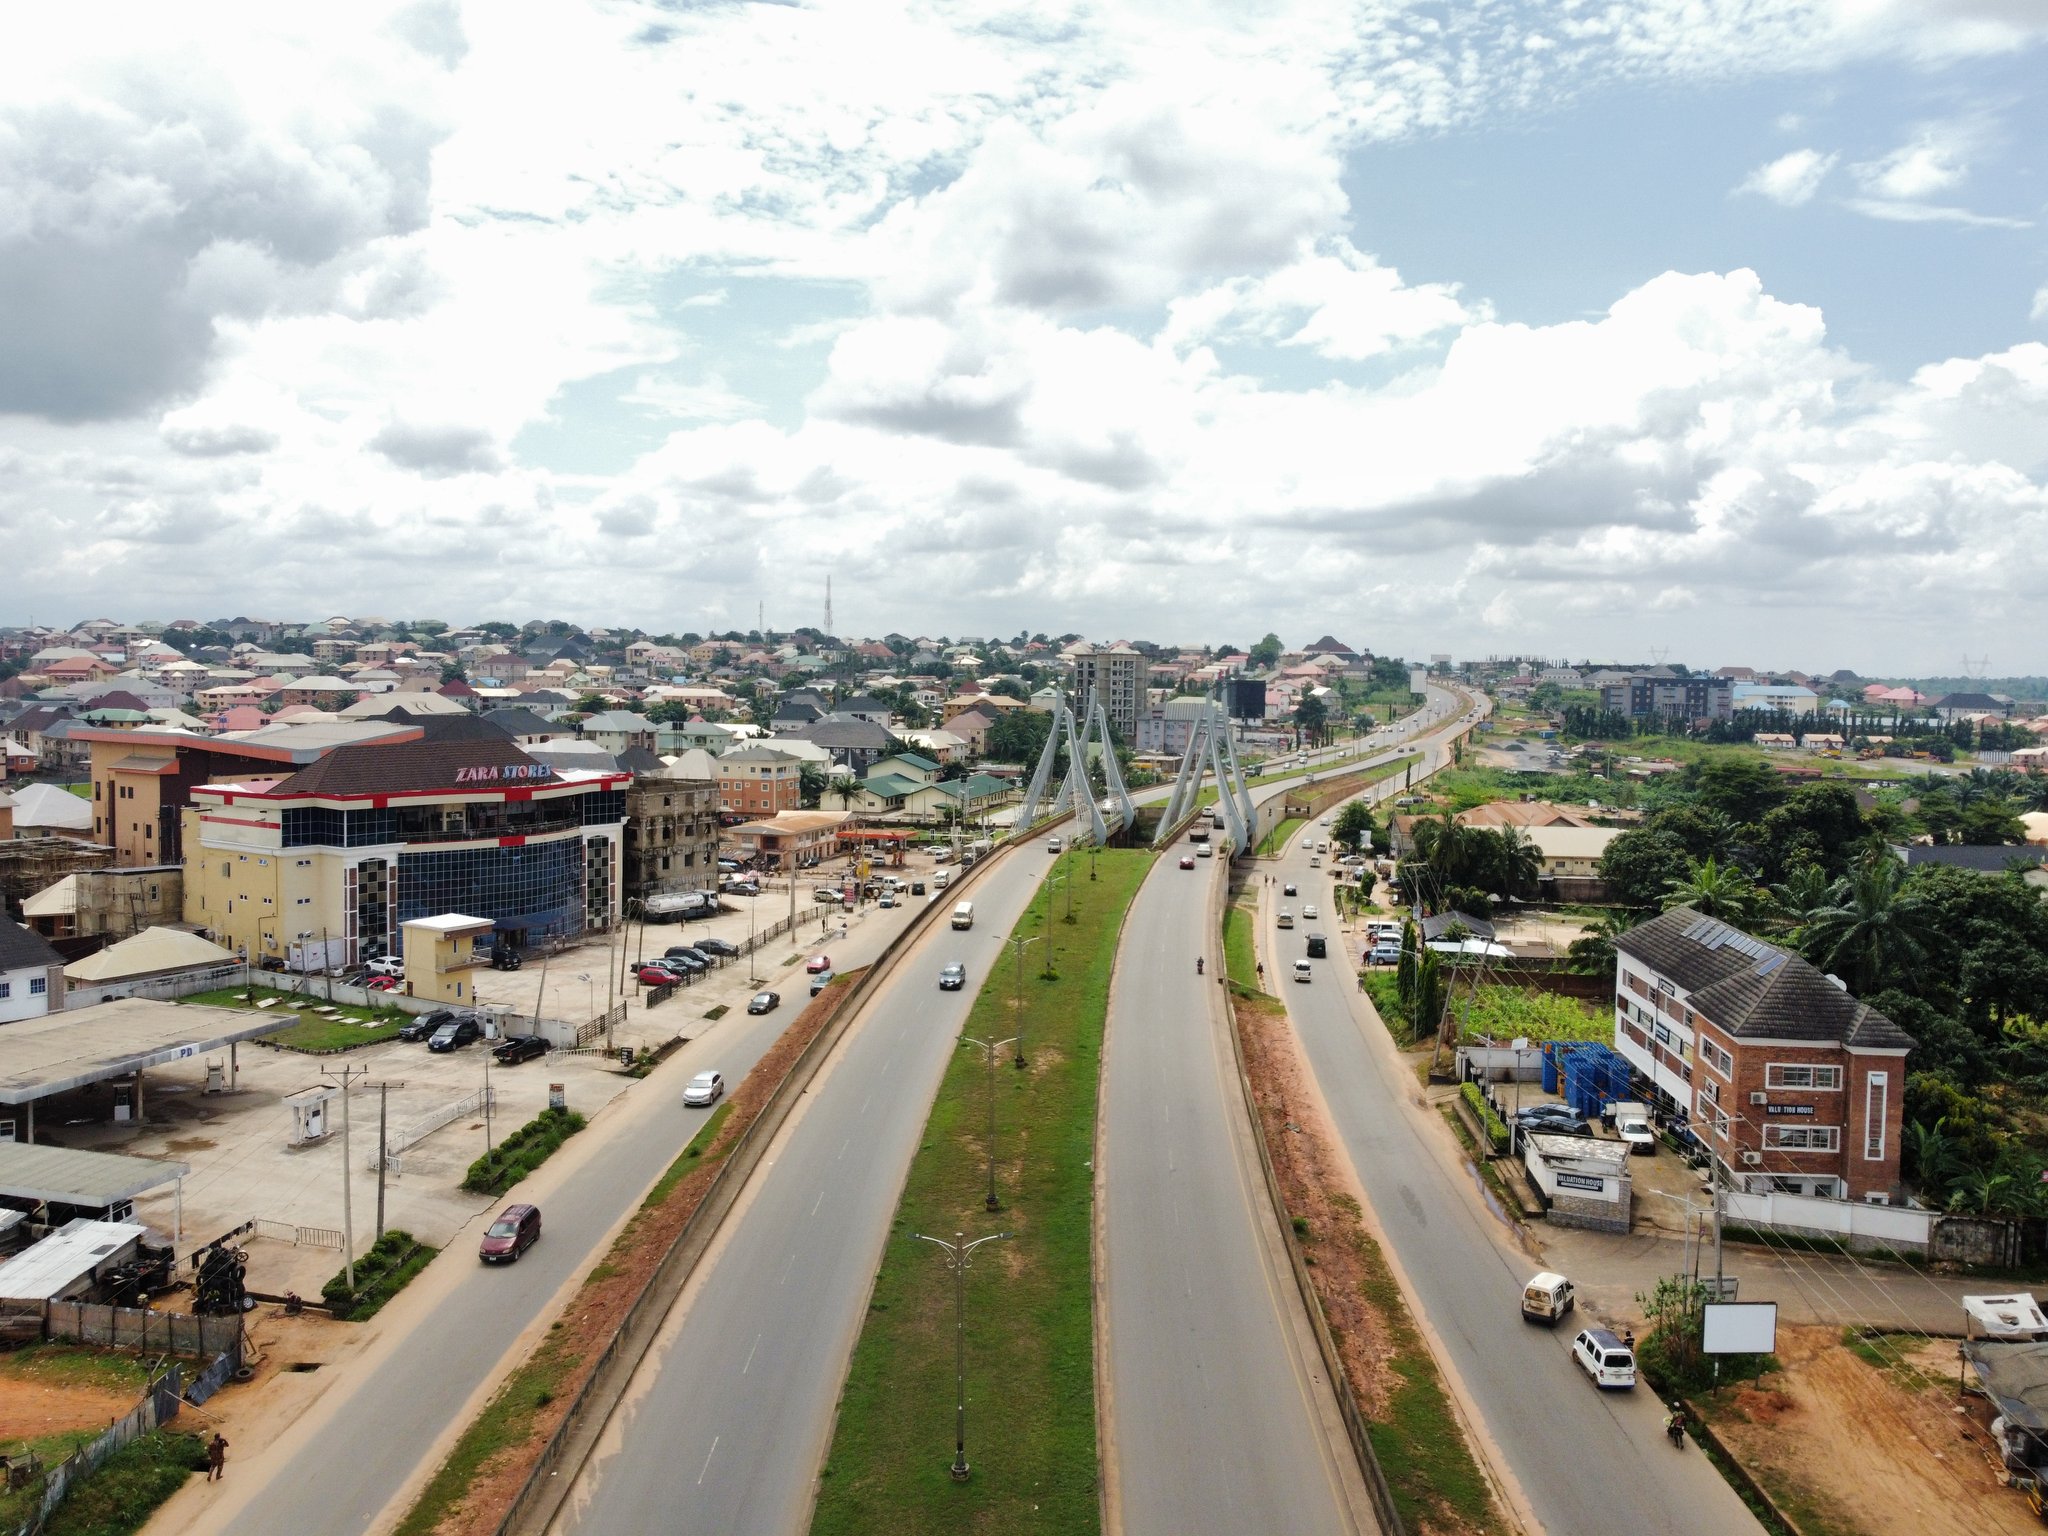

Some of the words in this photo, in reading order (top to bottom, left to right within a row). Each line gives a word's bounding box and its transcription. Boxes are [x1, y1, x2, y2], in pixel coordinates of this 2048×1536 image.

[456, 766, 499, 782] ZARA
[503, 763, 551, 779] STORES
[1796, 1106, 1814, 1114] HOUSE
[1557, 1174, 1586, 1185] VALUATION
[1585, 1178, 1603, 1187] HOUSE
